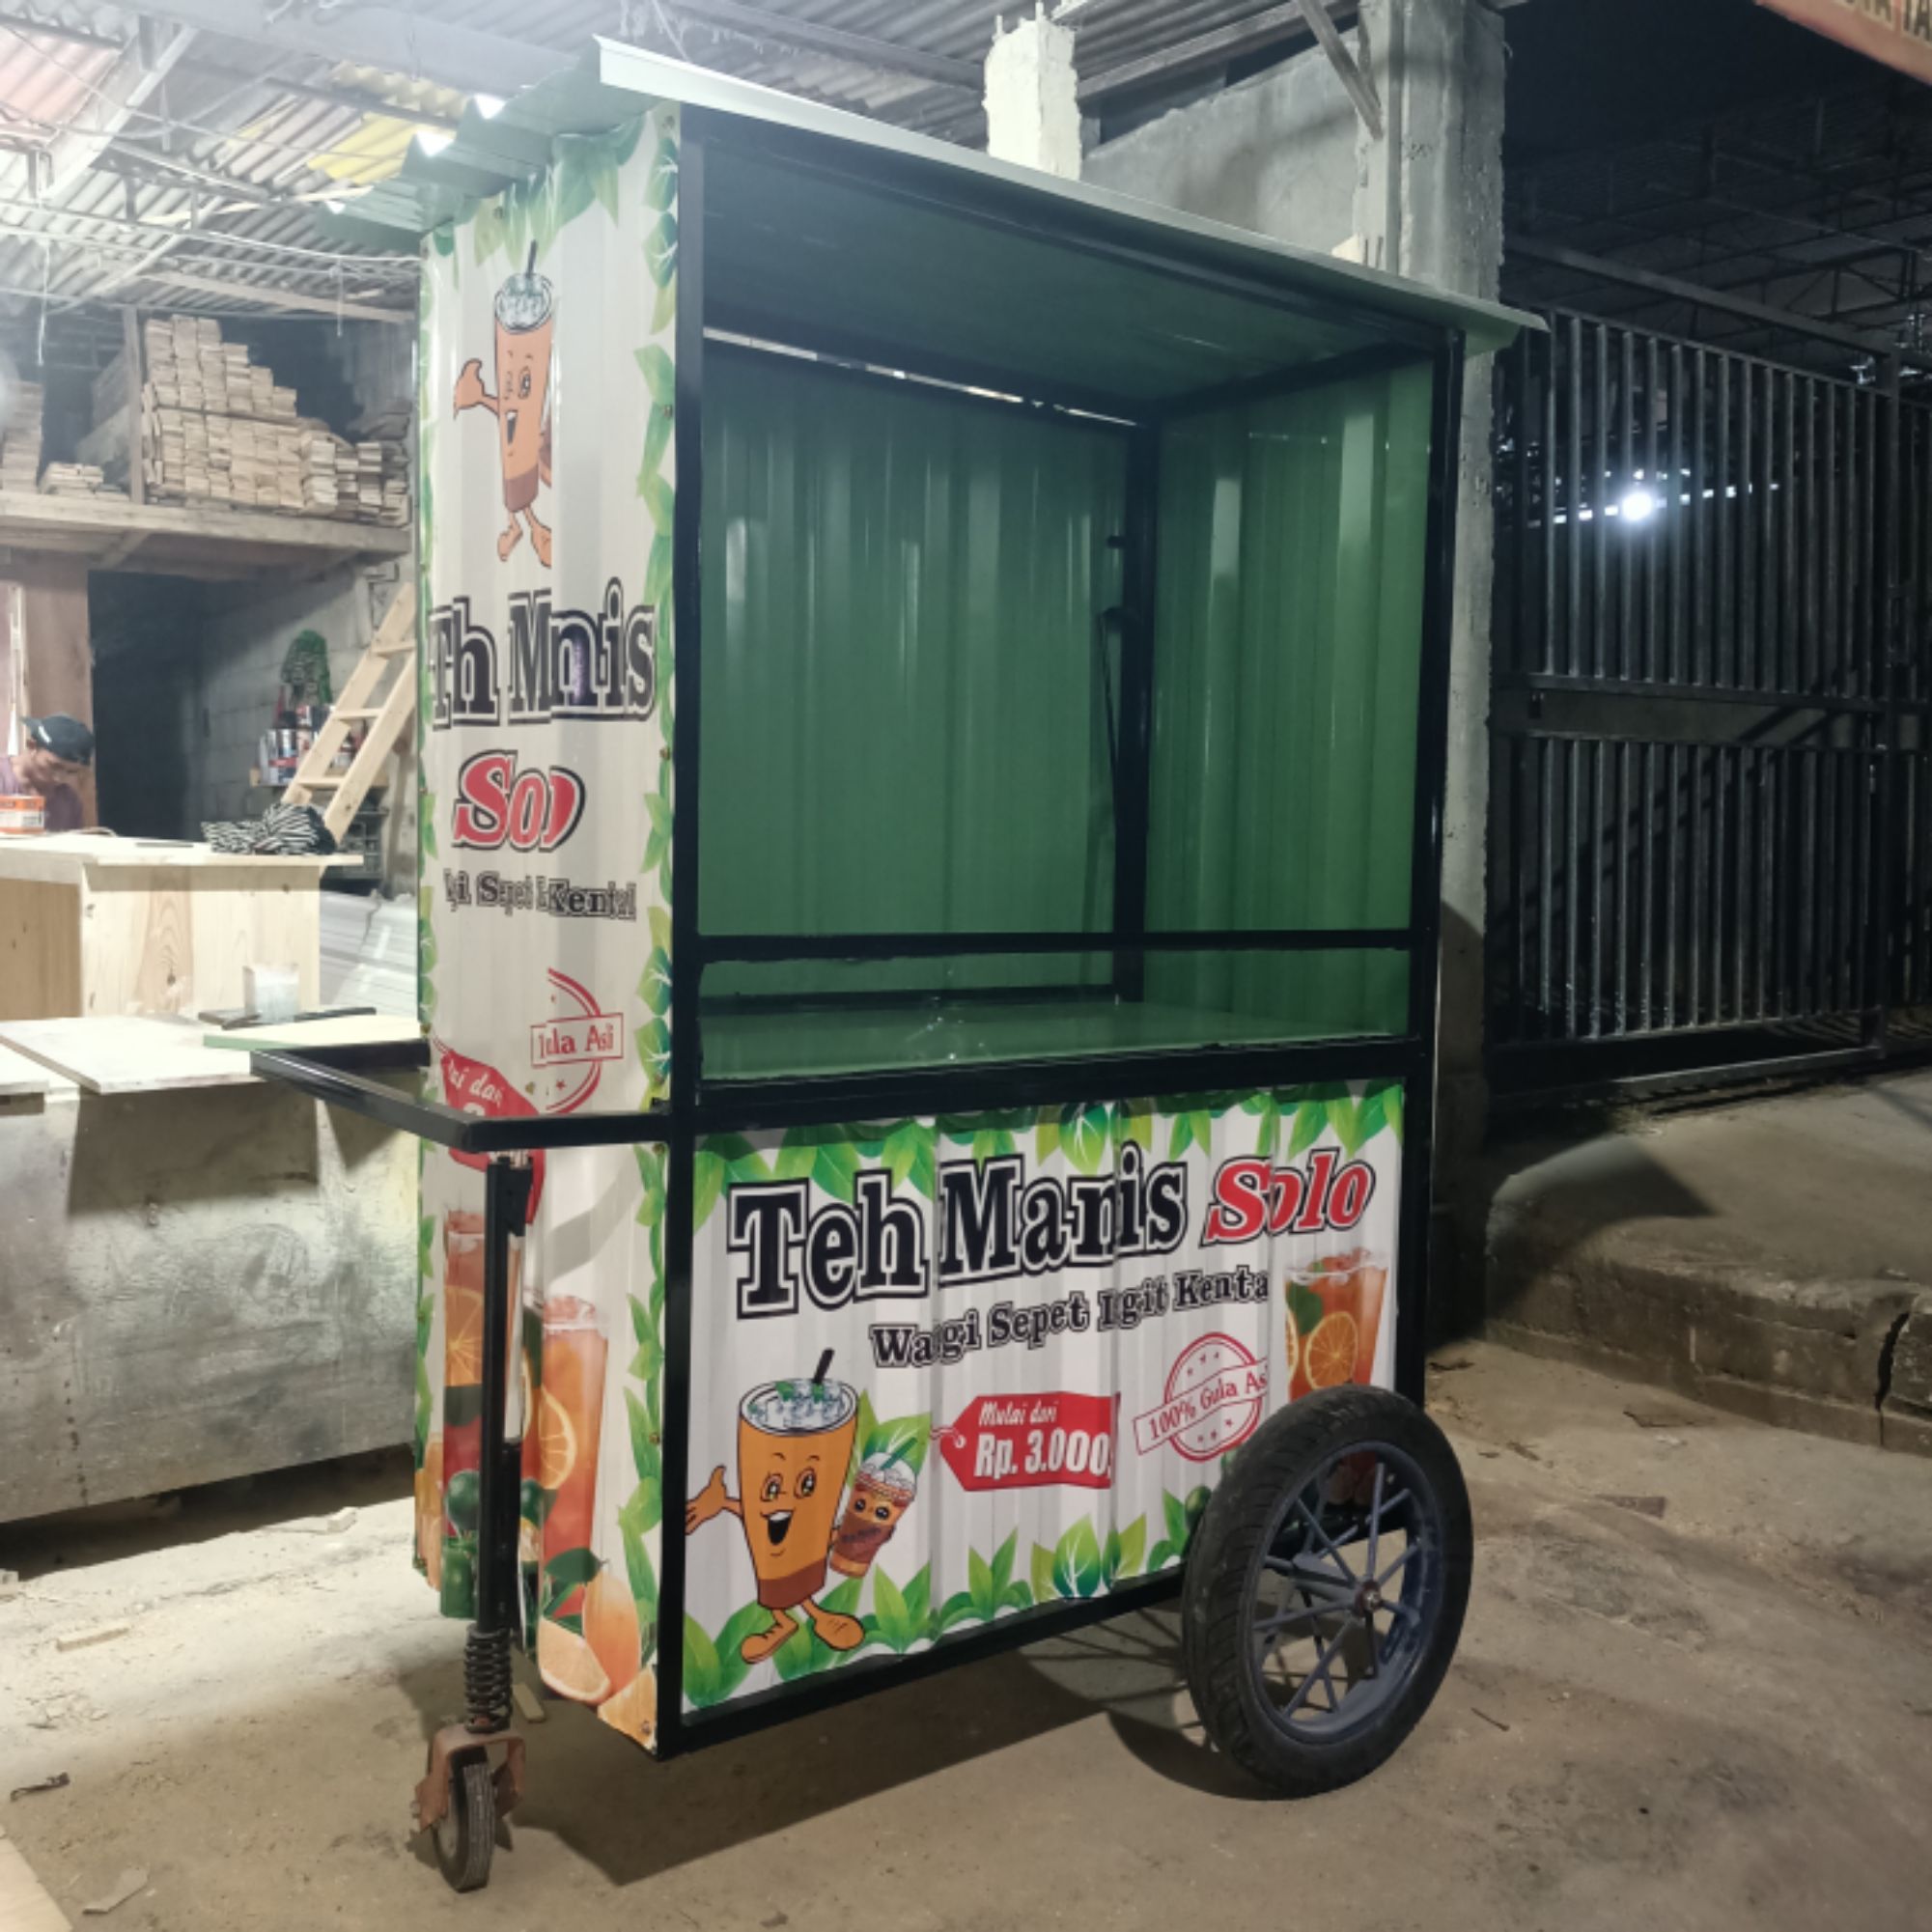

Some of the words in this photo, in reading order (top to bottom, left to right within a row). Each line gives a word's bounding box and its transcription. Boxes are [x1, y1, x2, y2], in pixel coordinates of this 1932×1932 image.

[726, 1167, 931, 1321] Teh
[937, 1139, 1189, 1290] Manis
[986, 1291, 1090, 1350] Sepet
[1170, 1265, 1270, 1312] Kenta
[978, 1400, 1027, 1427] Mulai
[1029, 1399, 1060, 1425] dari
[1200, 1377, 1239, 1410] Gula
[973, 1432, 1019, 1480] Rp.
